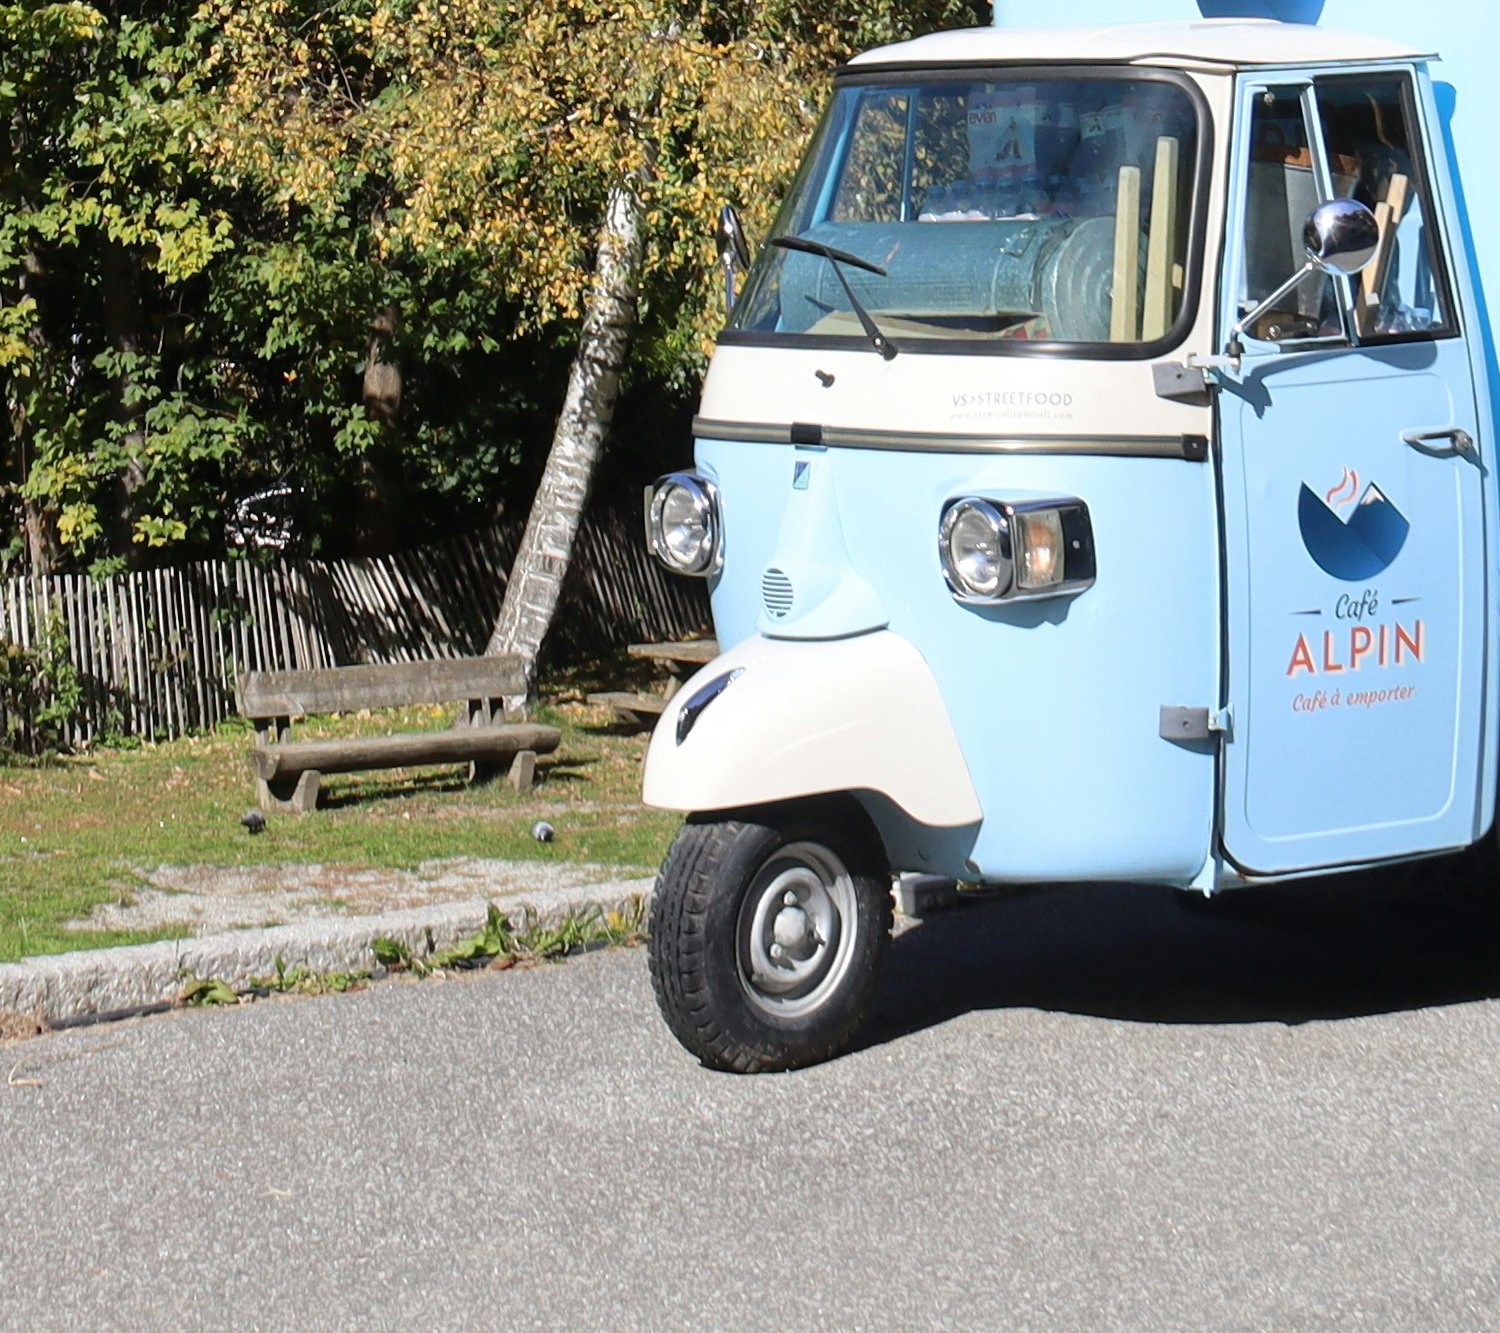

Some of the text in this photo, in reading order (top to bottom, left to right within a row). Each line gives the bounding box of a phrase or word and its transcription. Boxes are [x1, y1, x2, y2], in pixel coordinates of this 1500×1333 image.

[1335, 589, 1379, 621] Café
[1286, 619, 1421, 676] ALPIN
[1293, 685, 1415, 712] Café à emporter
